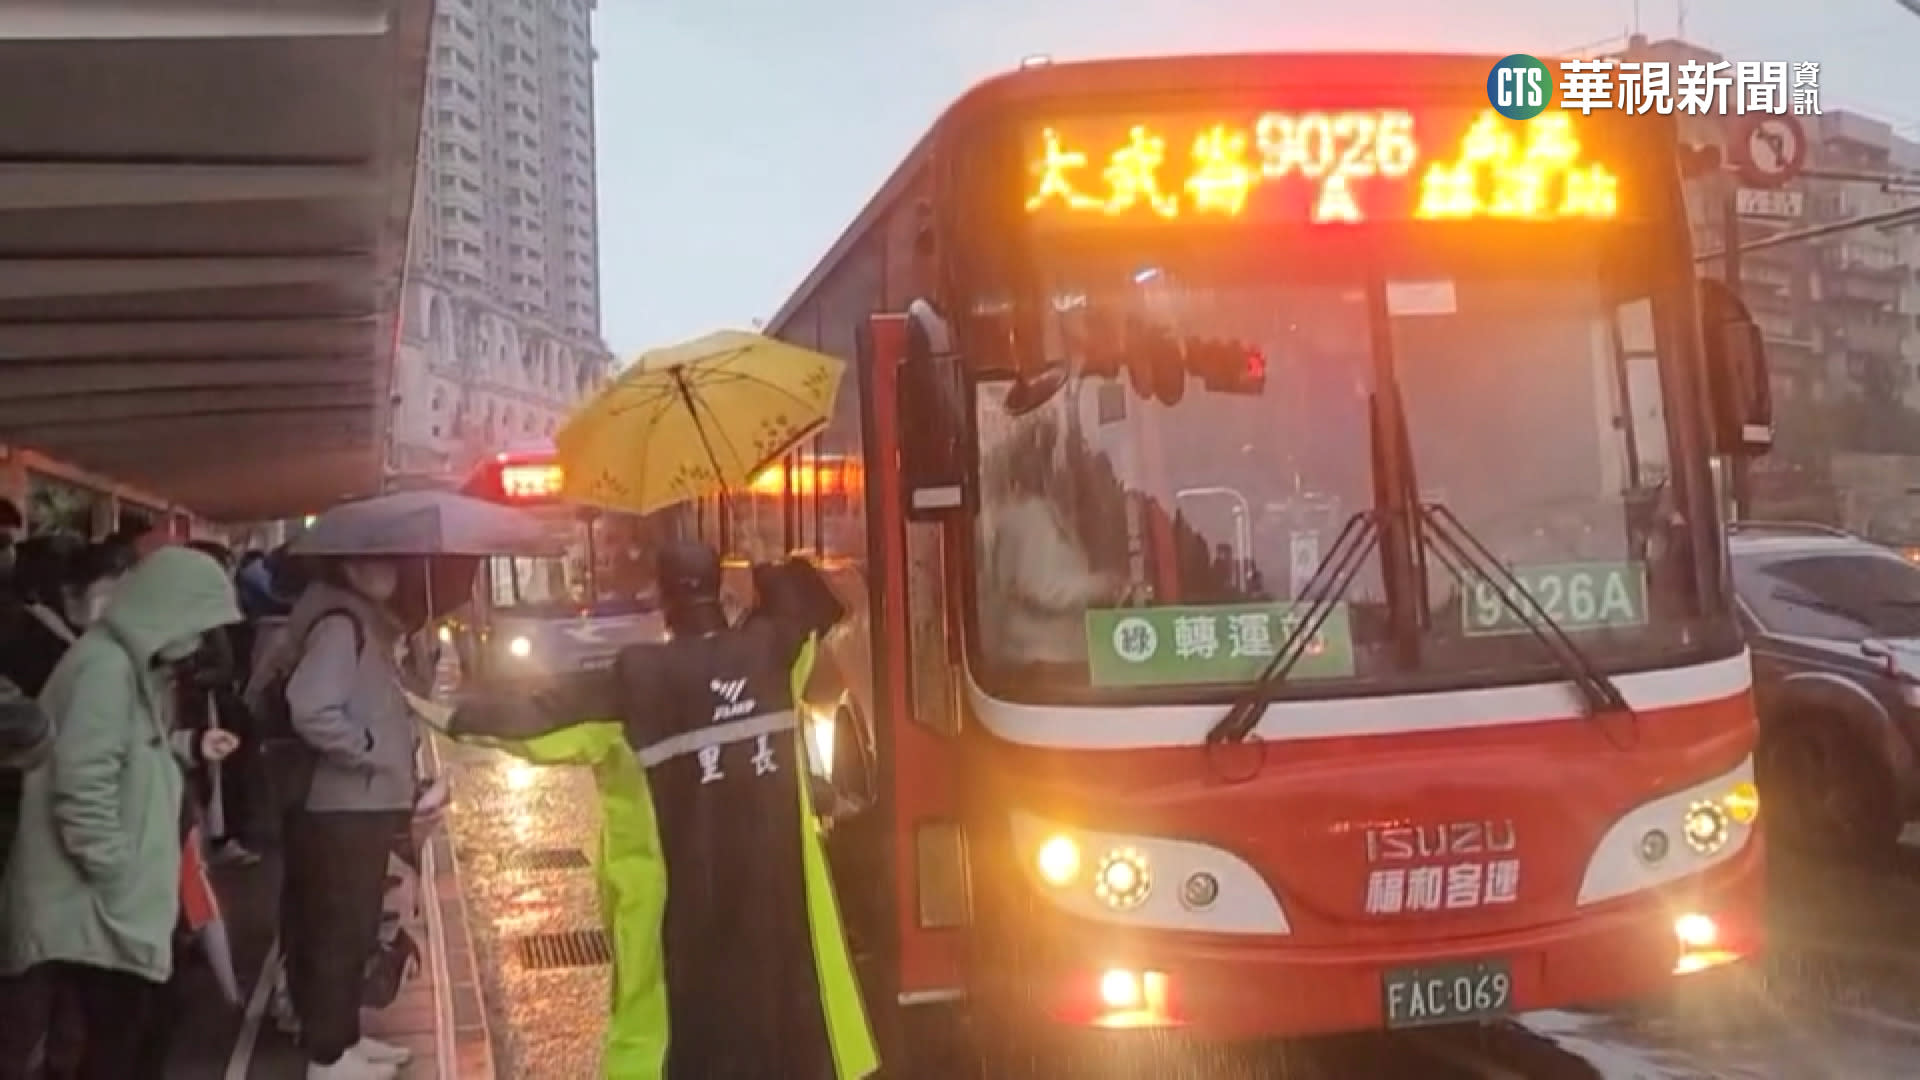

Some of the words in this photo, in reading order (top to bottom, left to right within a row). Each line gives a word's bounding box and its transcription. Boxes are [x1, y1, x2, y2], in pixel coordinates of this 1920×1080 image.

[1255, 112, 1417, 177] 9026
[1312, 173, 1363, 223] A
[1364, 820, 1516, 862] ISUZU
[1365, 858, 1521, 914] 福和客運
